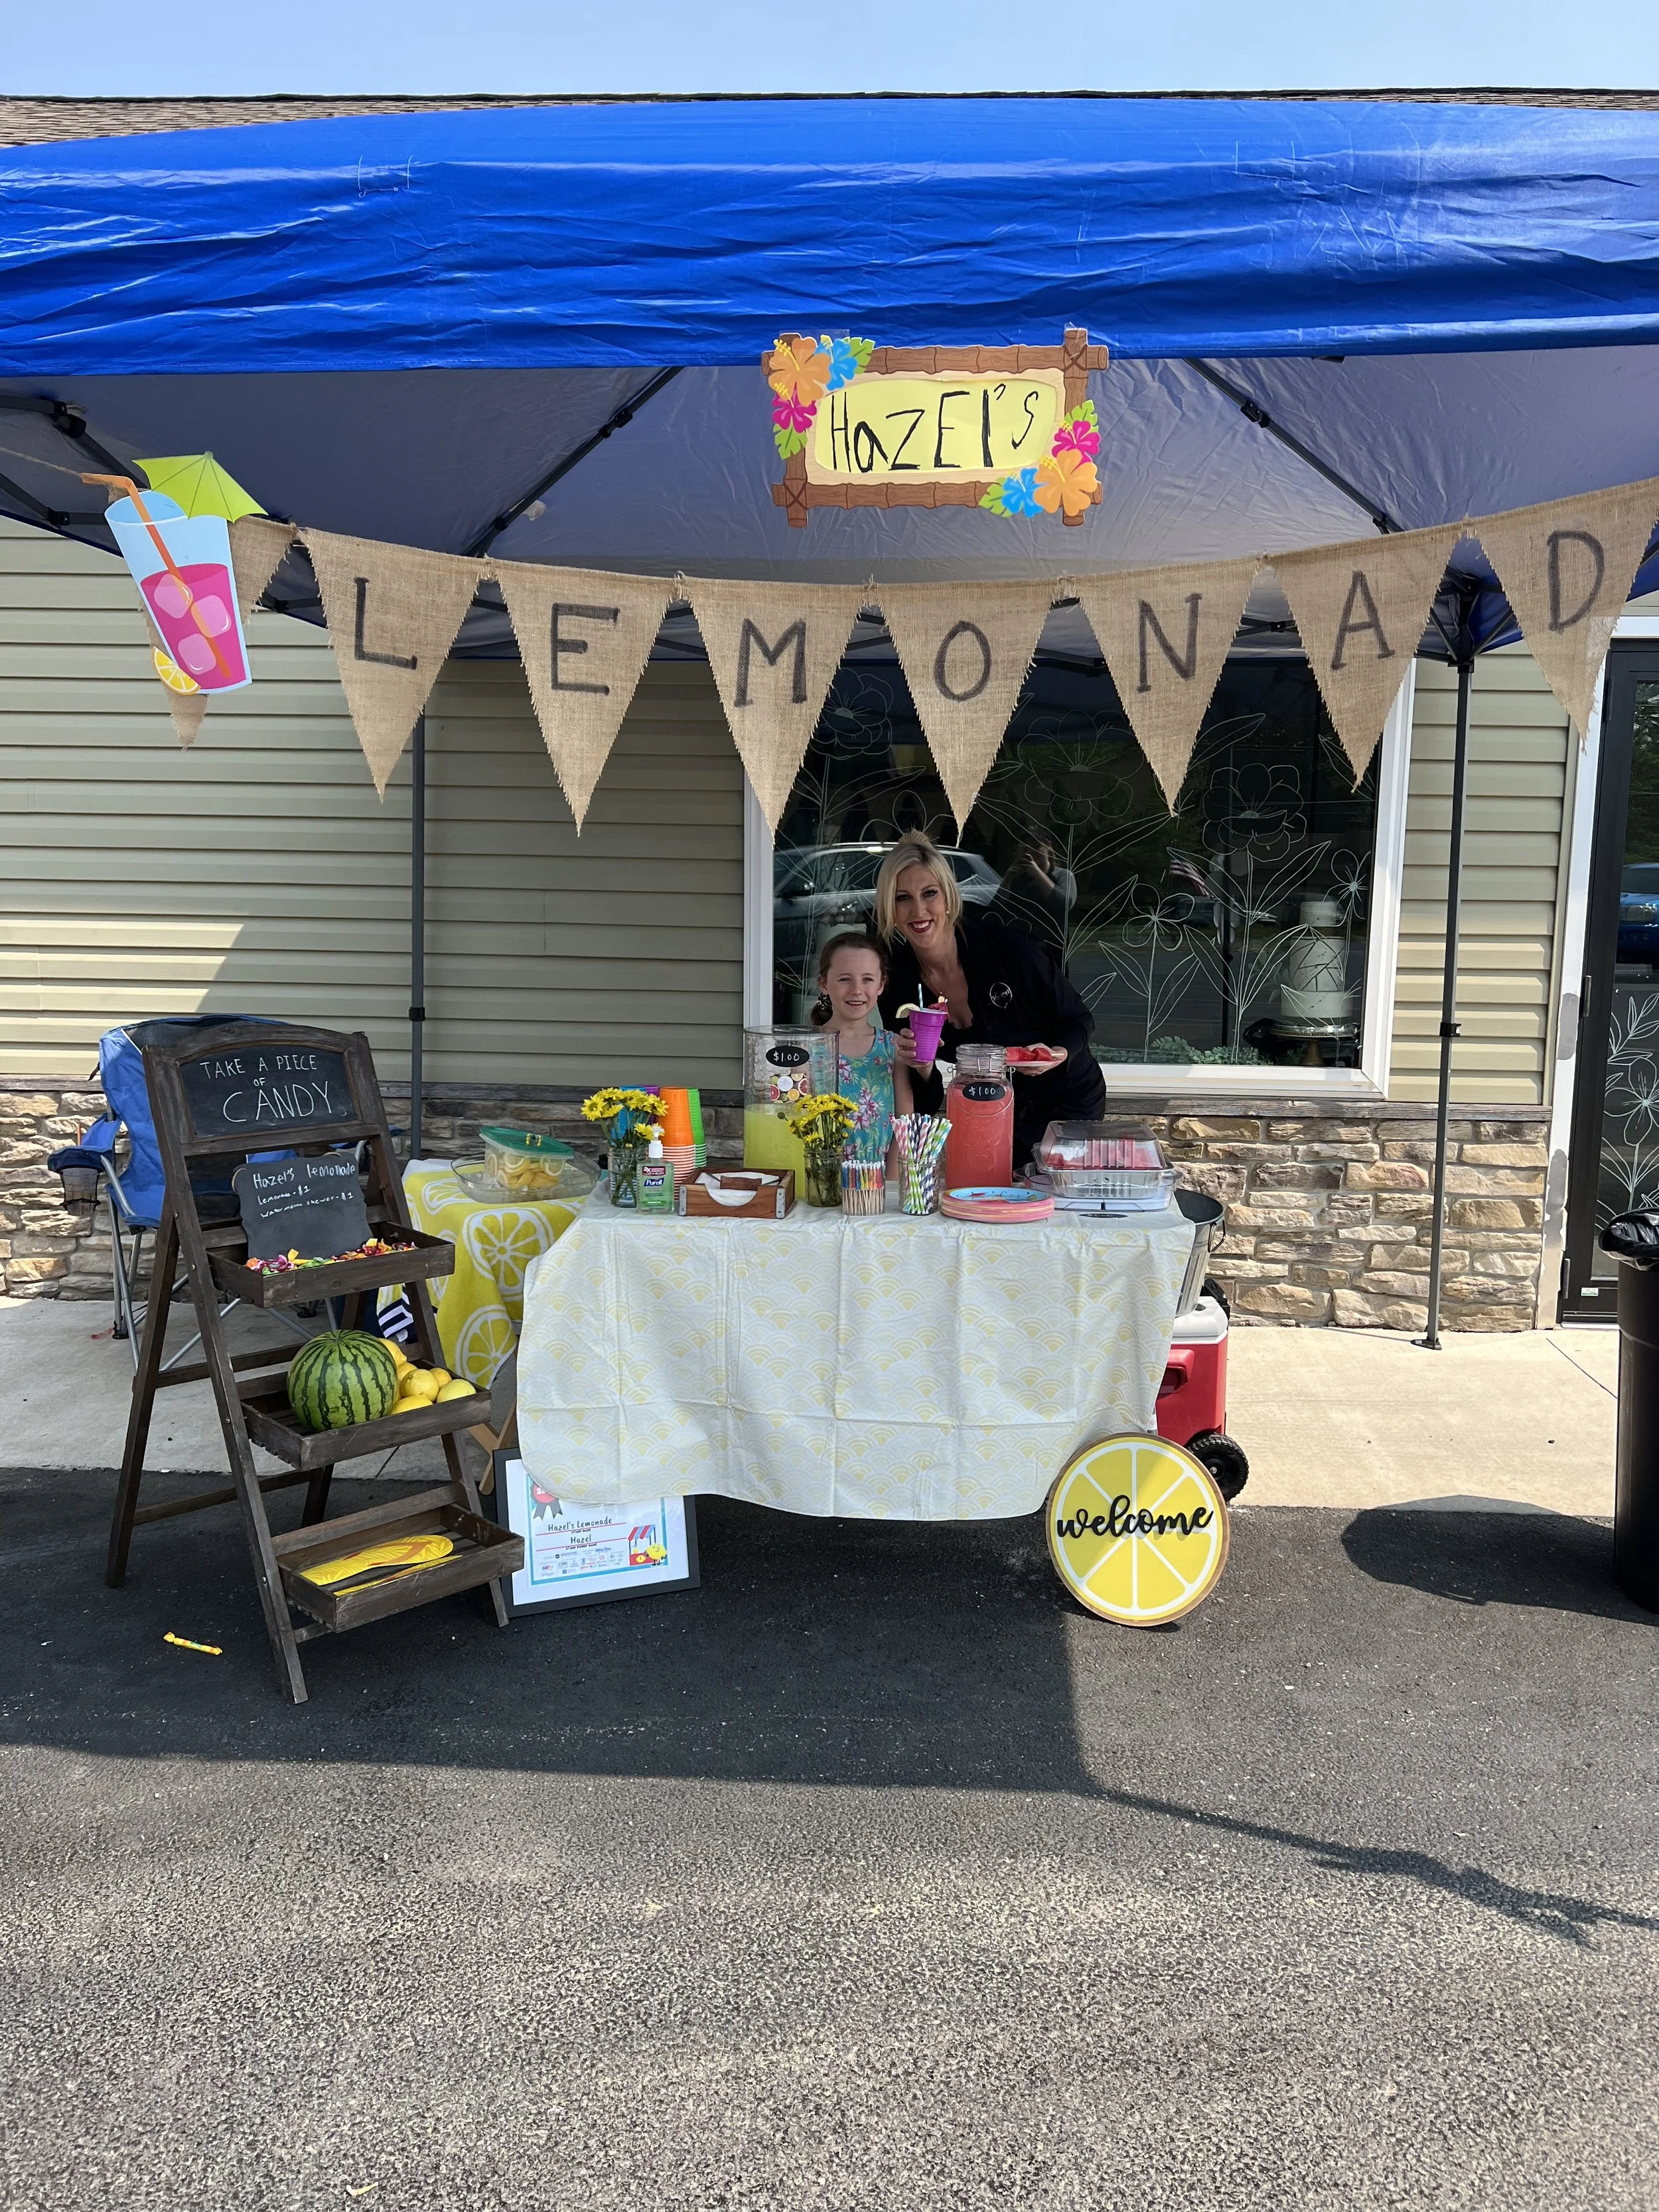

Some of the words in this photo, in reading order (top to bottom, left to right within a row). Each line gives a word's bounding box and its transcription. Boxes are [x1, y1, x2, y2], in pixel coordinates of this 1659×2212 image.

[773, 1050, 800, 1062] $1.00
[200, 1059, 246, 1078] TAKE
[259, 1057, 268, 1071] A
[276, 1055, 317, 1070] PIECE
[253, 1077, 265, 1086] OF
[968, 1086, 996, 1096] $1.00
[223, 1080, 332, 1122] CANDY
[253, 1167, 295, 1189] Hazel's
[548, 1522, 575, 1532] Hazel's
[577, 1516, 613, 1528] Lemonade
[1056, 1495, 1214, 1538] welcome
[571, 1534, 591, 1544] Hazel
